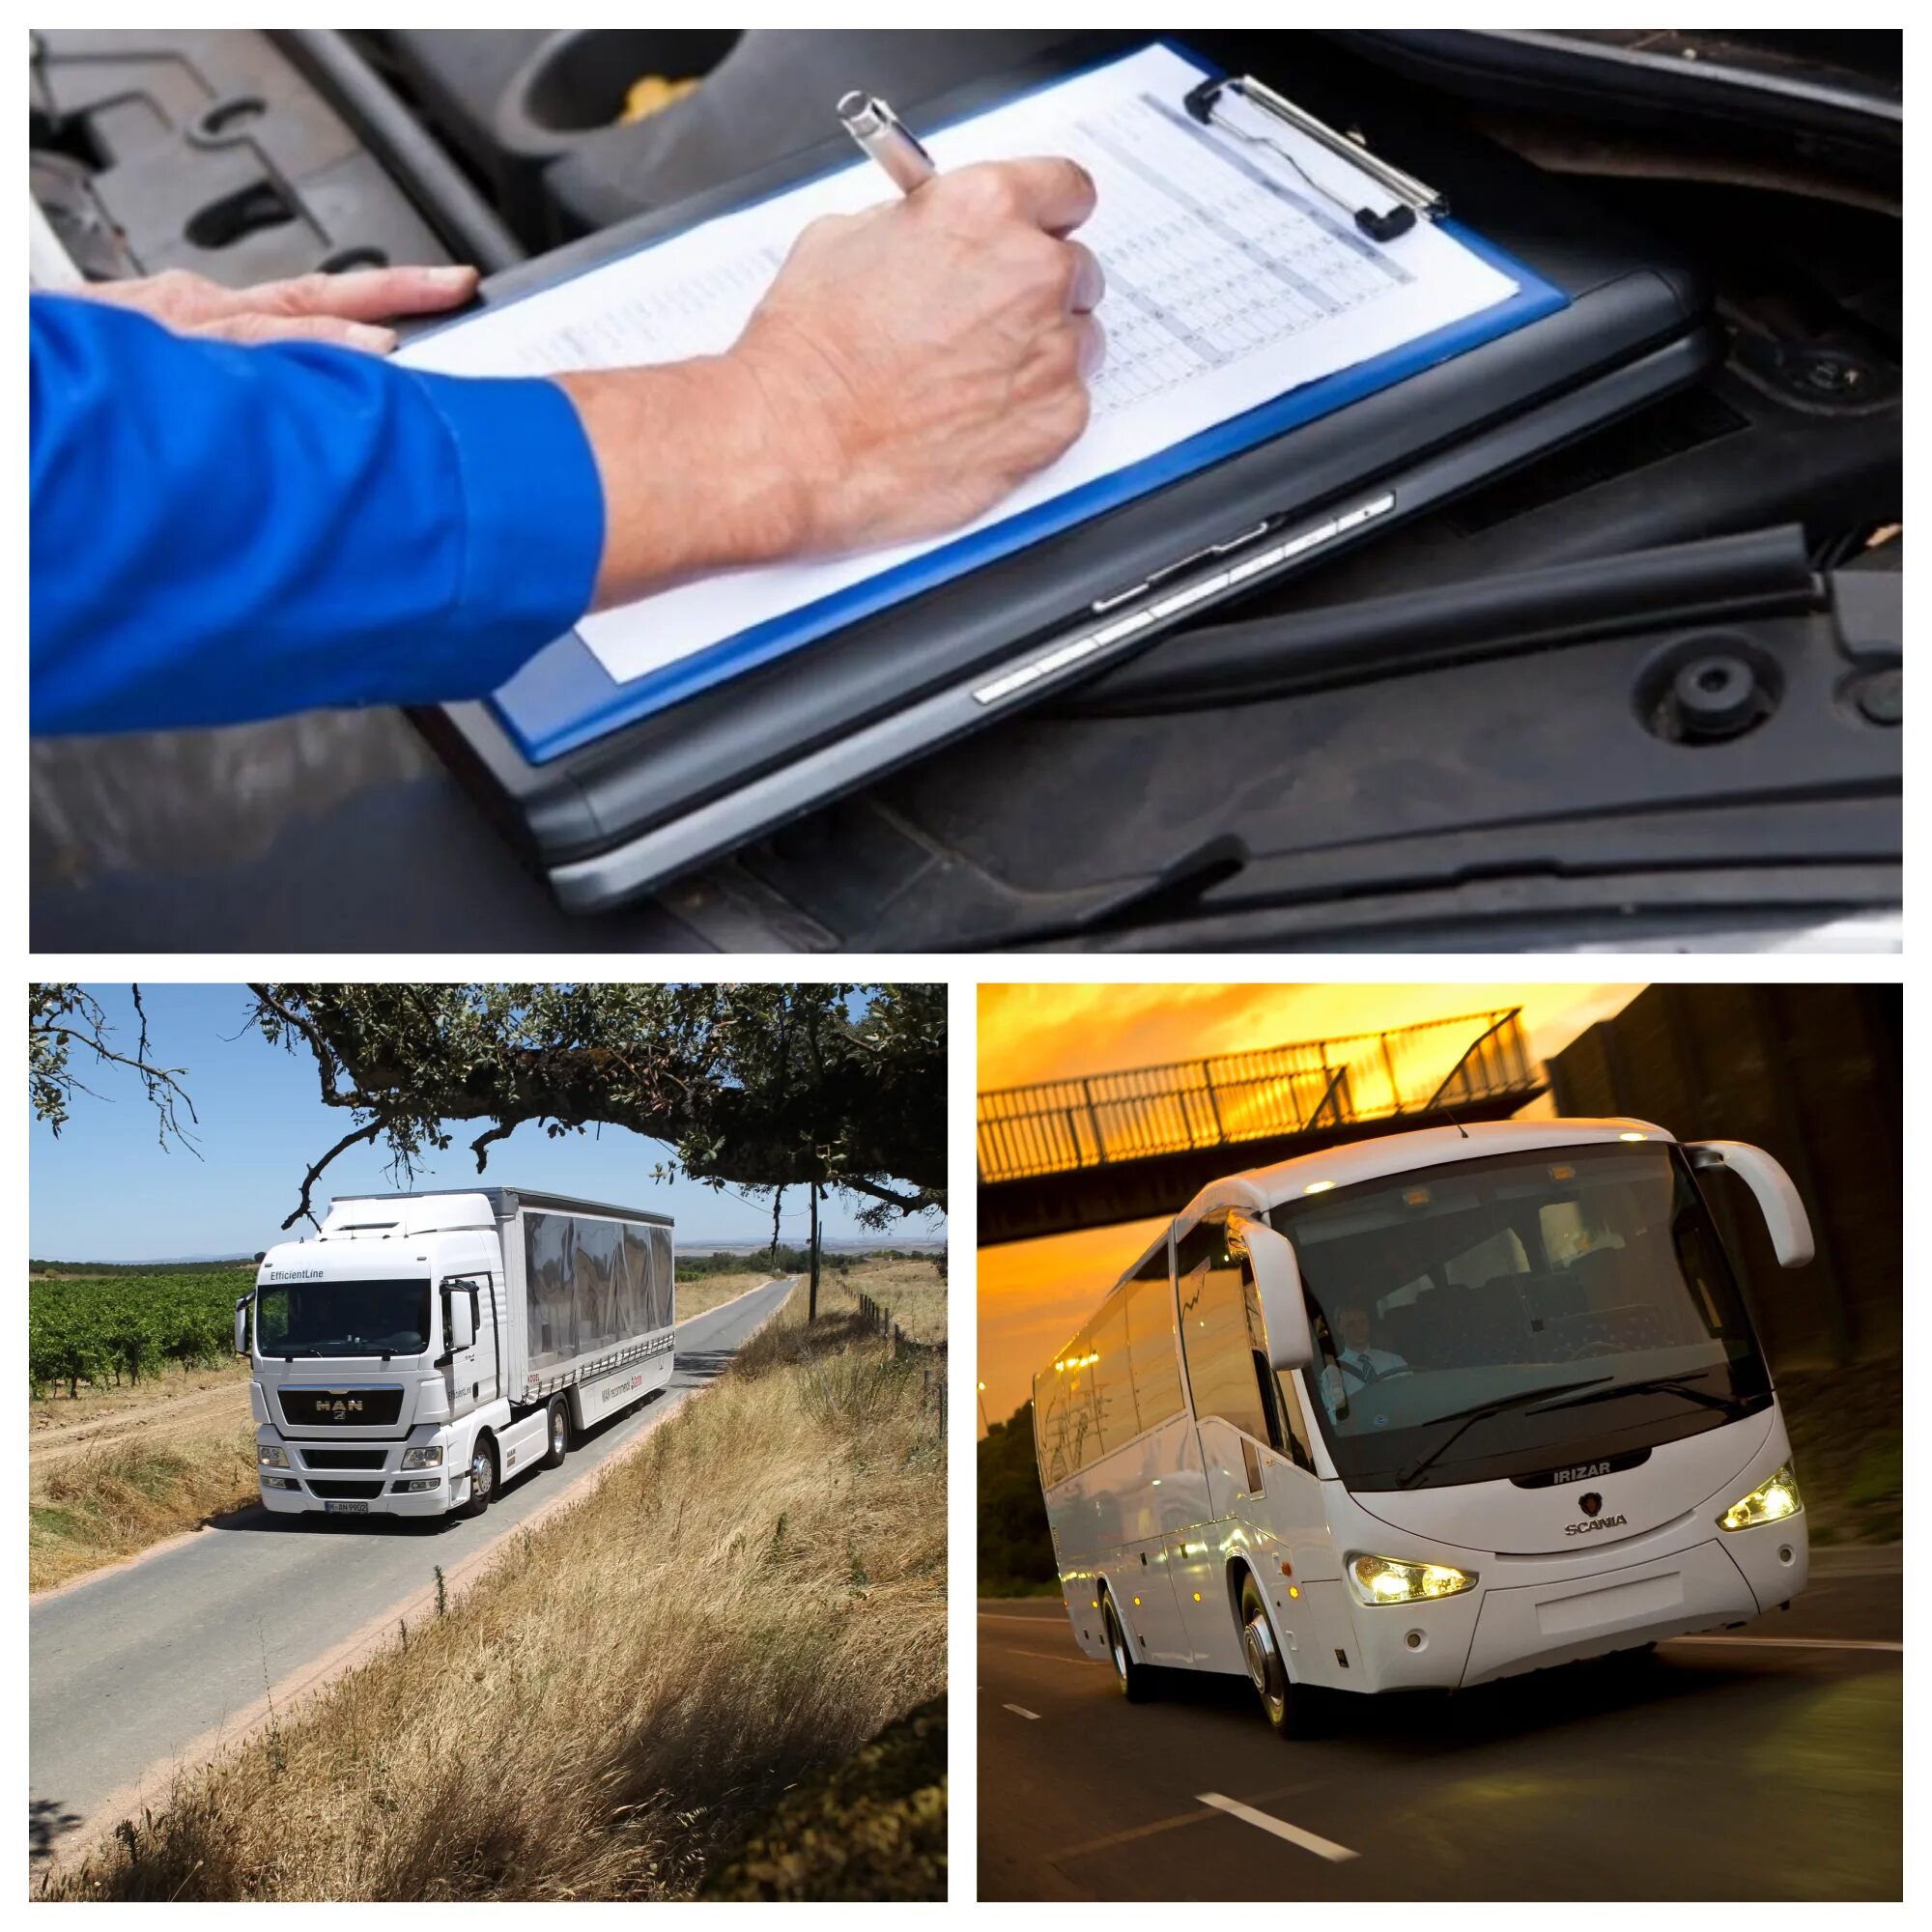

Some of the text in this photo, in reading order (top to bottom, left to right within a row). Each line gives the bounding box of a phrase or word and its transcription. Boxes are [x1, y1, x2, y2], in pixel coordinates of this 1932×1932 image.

[270, 1269, 324, 1281] EfficientLine
[316, 1400, 363, 1411] MAN
[1553, 1462, 1611, 1485] IRIZAR
[1564, 1514, 1628, 1536] SCANIA
